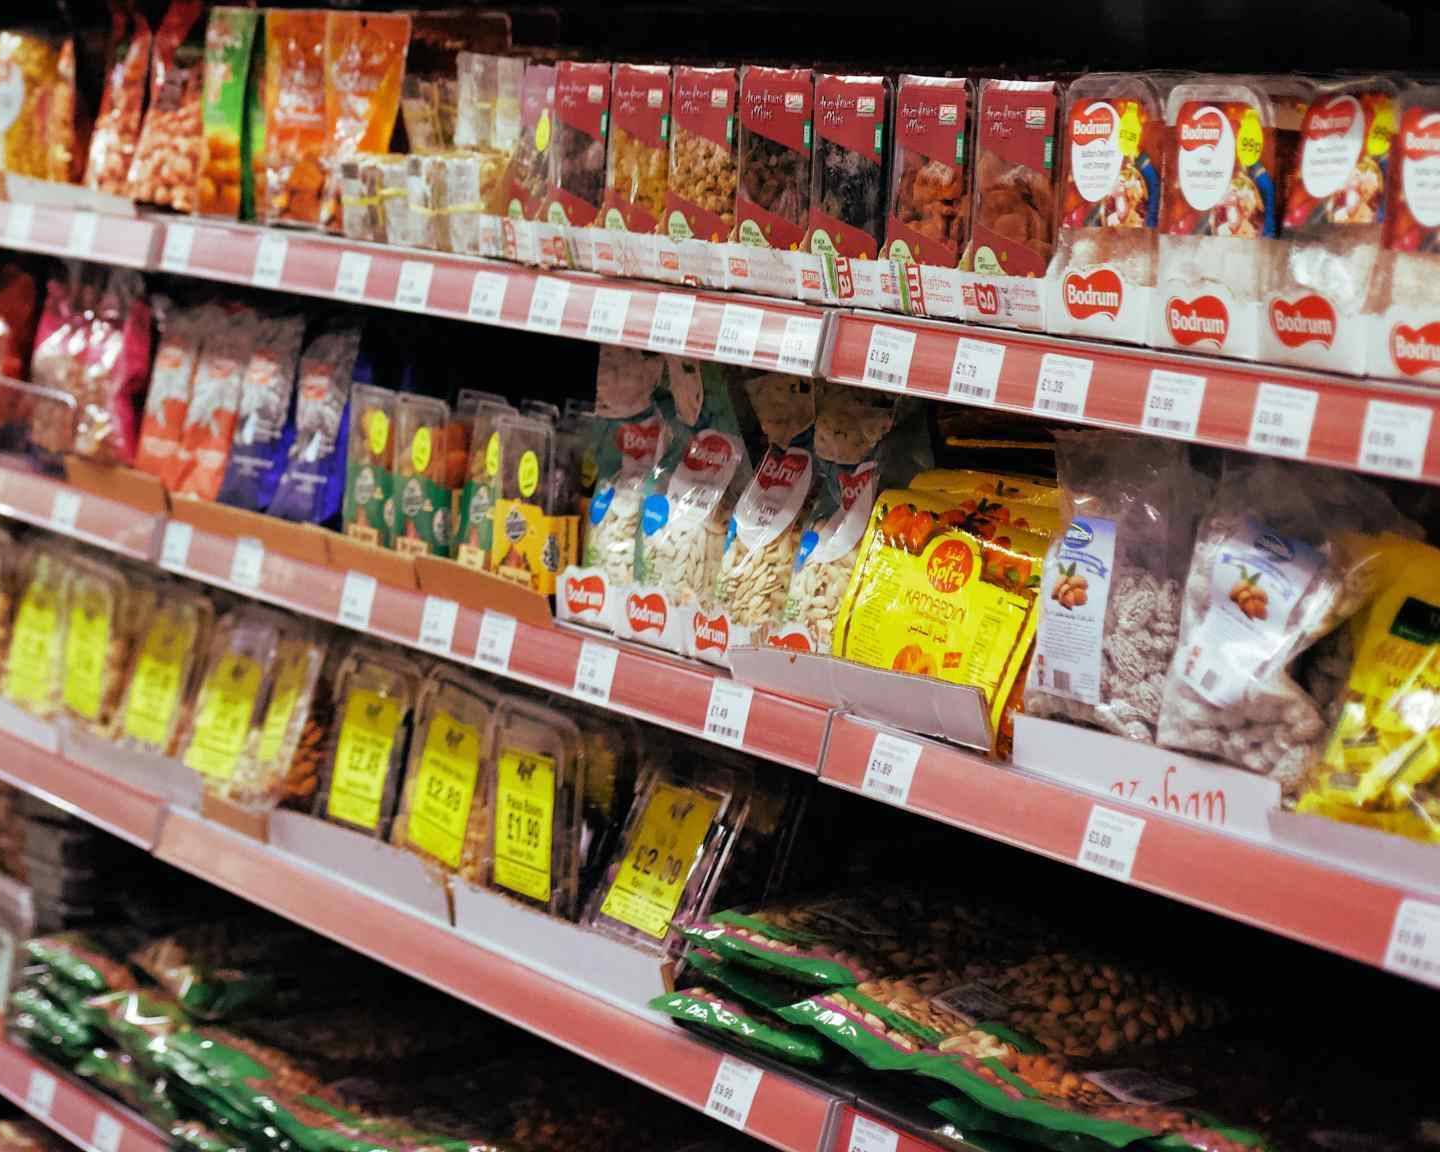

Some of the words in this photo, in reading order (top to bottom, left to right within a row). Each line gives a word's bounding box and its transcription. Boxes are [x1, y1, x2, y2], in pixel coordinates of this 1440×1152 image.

[1072, 119, 1112, 136] Bodrum
[1180, 124, 1220, 141] Bodrum
[1241, 137, 1264, 156] 99p
[1067, 282, 1119, 308] Bodrum
[1171, 308, 1224, 335] Bodrum
[1274, 309, 1332, 336] Bodrum
[870, 349, 890, 365] £1.99
[1396, 334, 1440, 362] Bodru
[567, 585, 603, 607] Bodrum
[630, 599, 665, 625] Bodrum
[507, 811, 540, 849] £1.99
